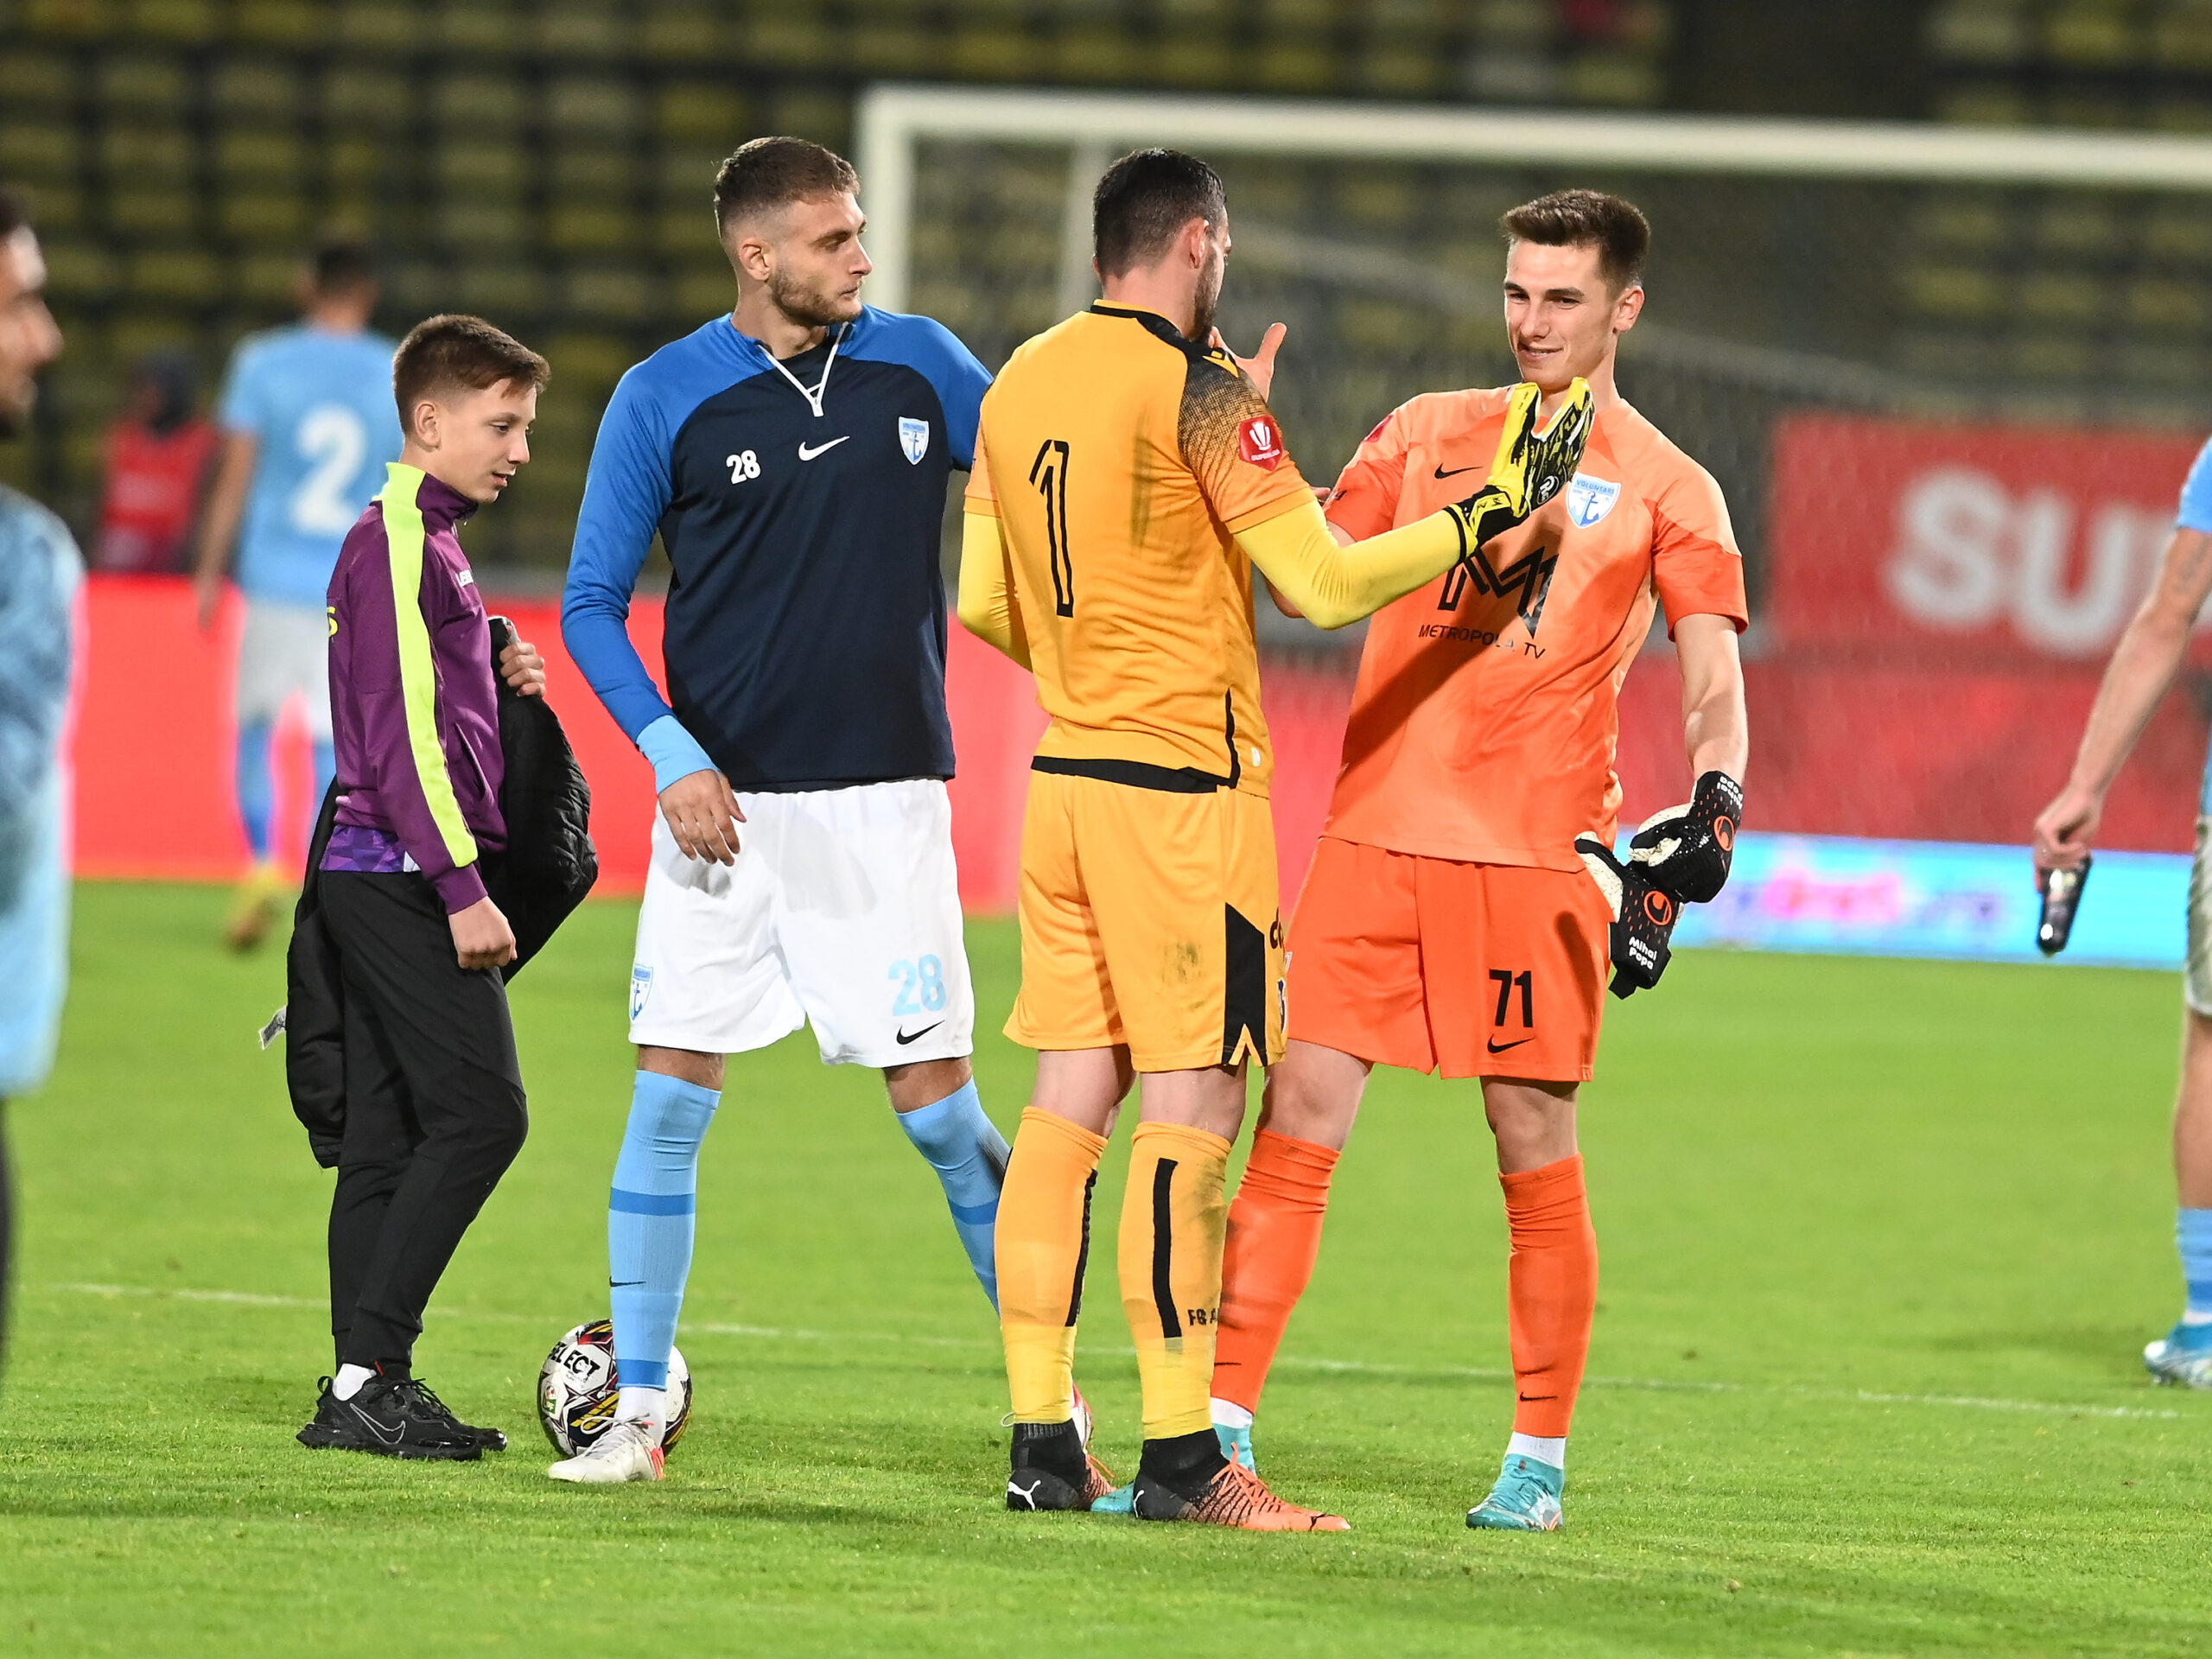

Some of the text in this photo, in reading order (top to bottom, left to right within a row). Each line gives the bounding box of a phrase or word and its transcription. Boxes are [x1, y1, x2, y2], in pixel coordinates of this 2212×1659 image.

[292, 403, 366, 537] 2
[726, 449, 761, 485] 28
[1576, 479, 1615, 495] VOLUNTARI
[1029, 439, 1074, 618] 1
[1891, 463, 2169, 655] SU
[1418, 624, 1546, 659] METROPOLA TV
[1628, 936, 1657, 961] Mihai
[887, 953, 947, 1016] 28
[1489, 969, 1534, 1028] 71
[549, 1341, 601, 1382] ELECT
